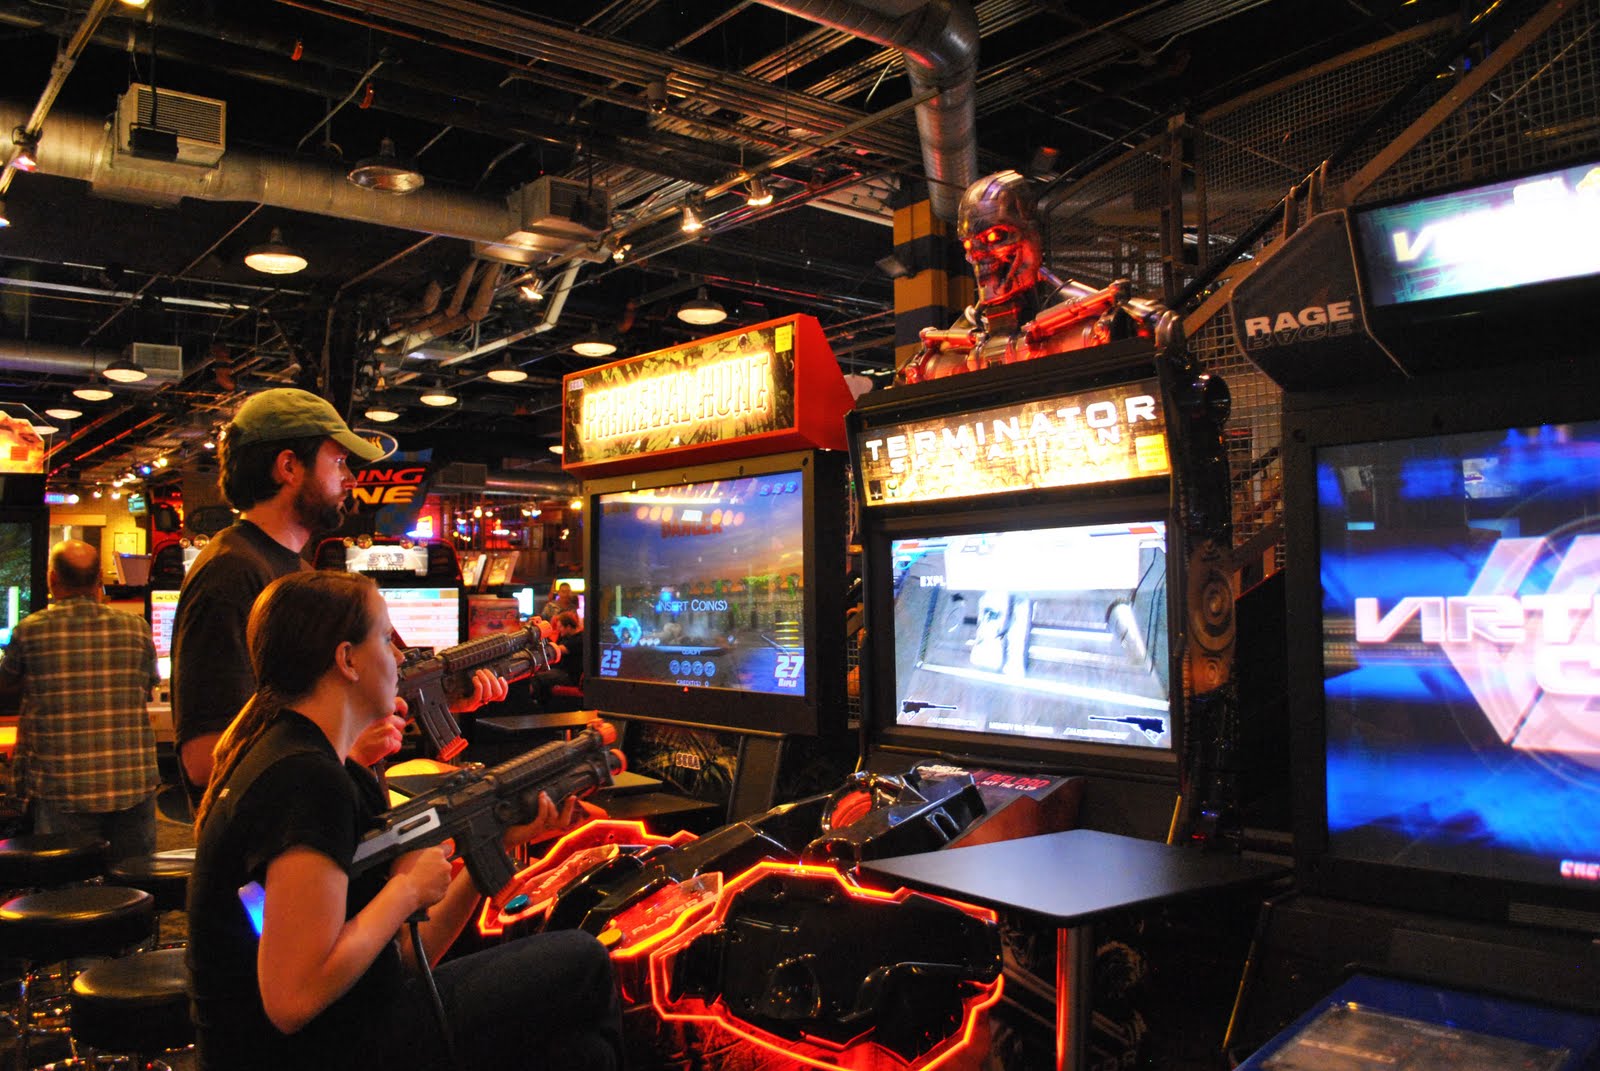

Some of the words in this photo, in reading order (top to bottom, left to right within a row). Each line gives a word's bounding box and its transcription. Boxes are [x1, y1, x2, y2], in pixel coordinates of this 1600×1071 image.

[1245, 301, 1354, 336] RAGE
[698, 352, 769, 419] HUNT
[866, 395, 1157, 461] TERMINATOR
[357, 467, 426, 484] ING
[352, 485, 418, 504] NE
[1355, 596, 1600, 643] VIRT
[601, 649, 622, 669] 23
[774, 655, 804, 678] 27
[676, 752, 701, 770] SEGA
[632, 898, 699, 935] PLAYER
